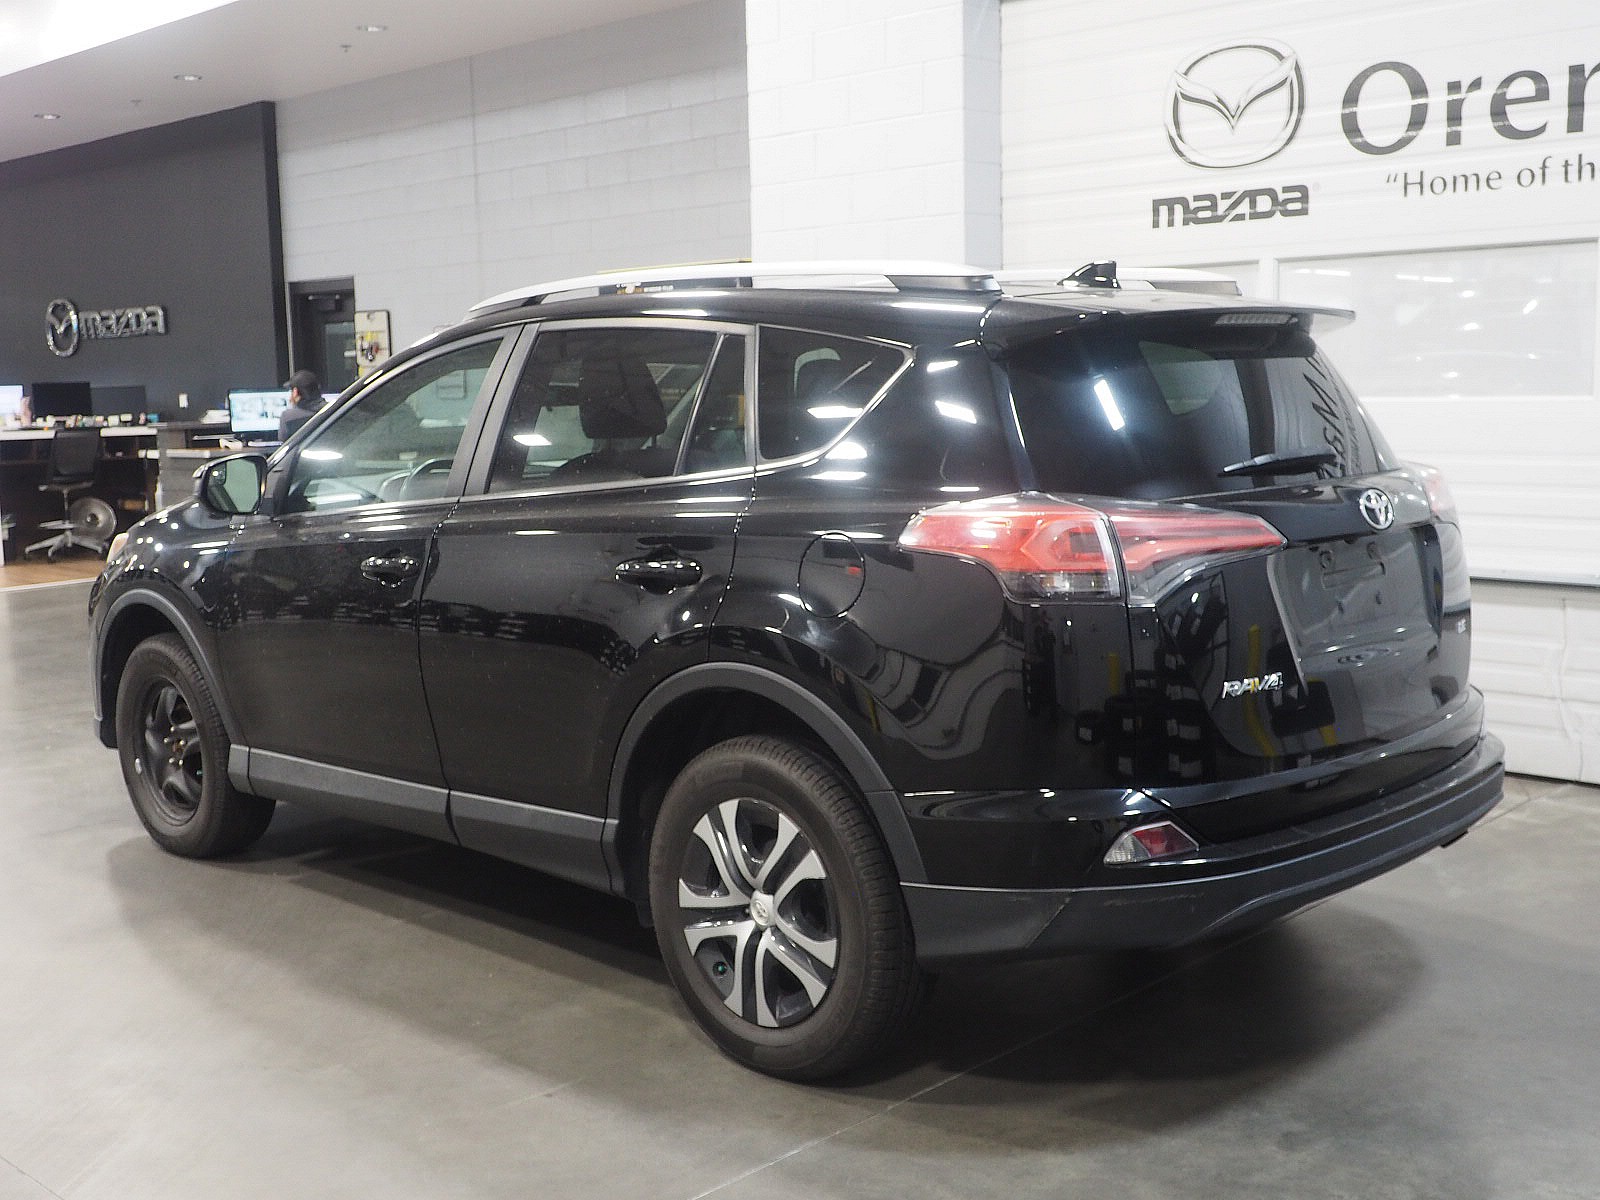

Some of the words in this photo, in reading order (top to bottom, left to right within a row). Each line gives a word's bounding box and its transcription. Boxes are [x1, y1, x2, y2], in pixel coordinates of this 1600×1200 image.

[1516, 155, 1553, 188] of
[1561, 153, 1600, 184] th
[1221, 671, 1284, 699] RAV4
